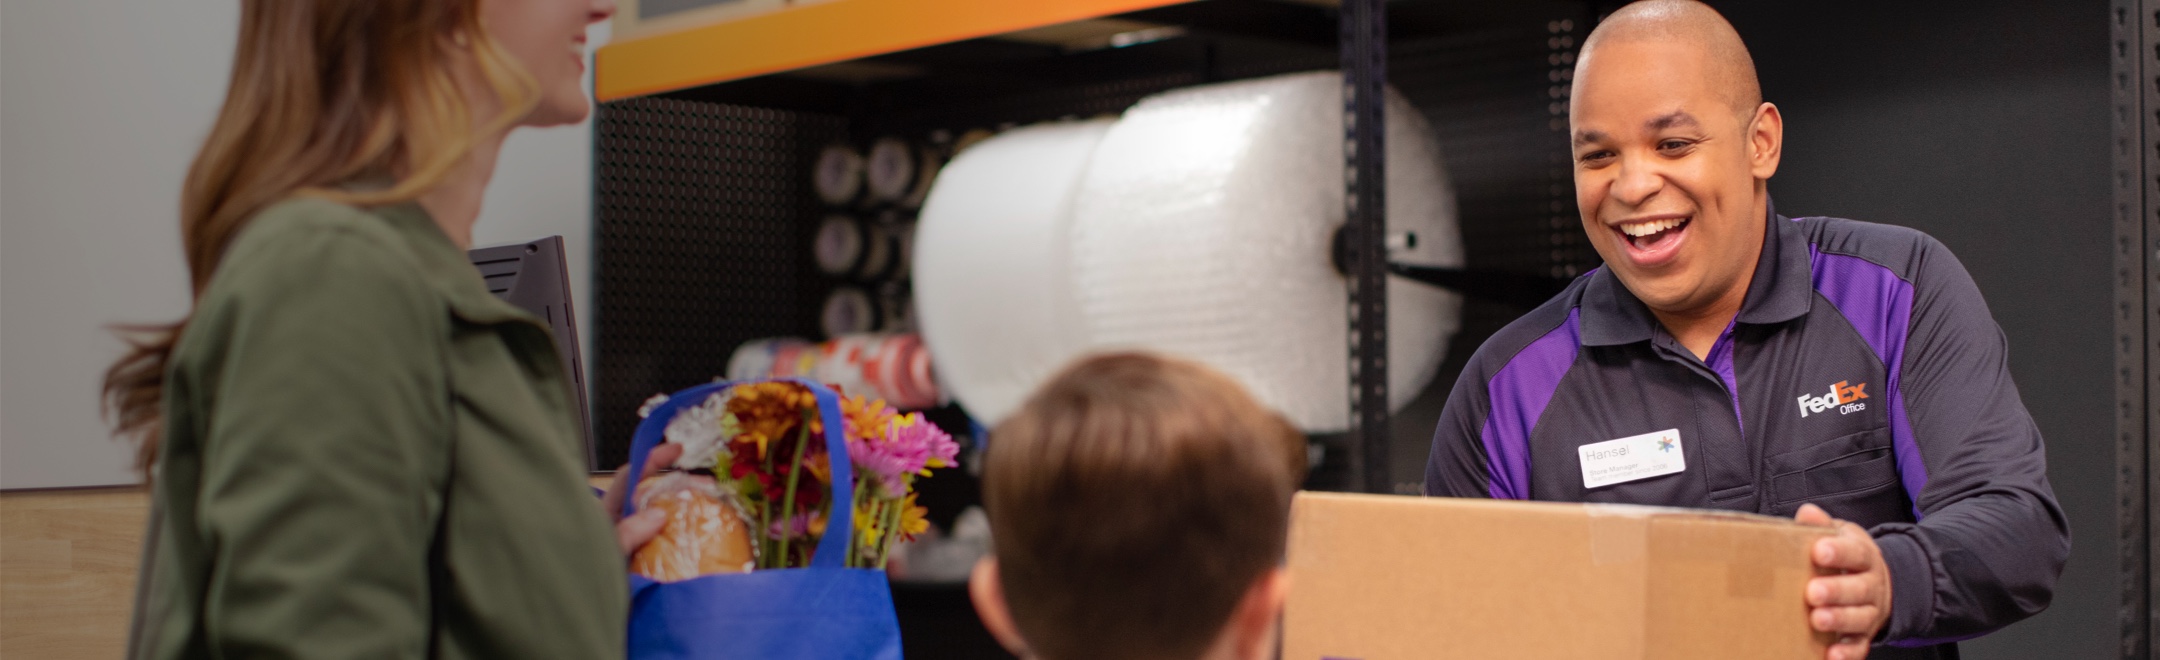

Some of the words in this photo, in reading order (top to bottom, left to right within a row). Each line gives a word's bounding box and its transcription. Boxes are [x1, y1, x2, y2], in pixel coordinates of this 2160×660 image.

[1797, 380, 1869, 418] FedEx
[1840, 403, 1865, 415] Office
[1586, 445, 1630, 461] Hansel
[1589, 468, 1607, 476] Store
[1609, 463, 1638, 473] Manager
